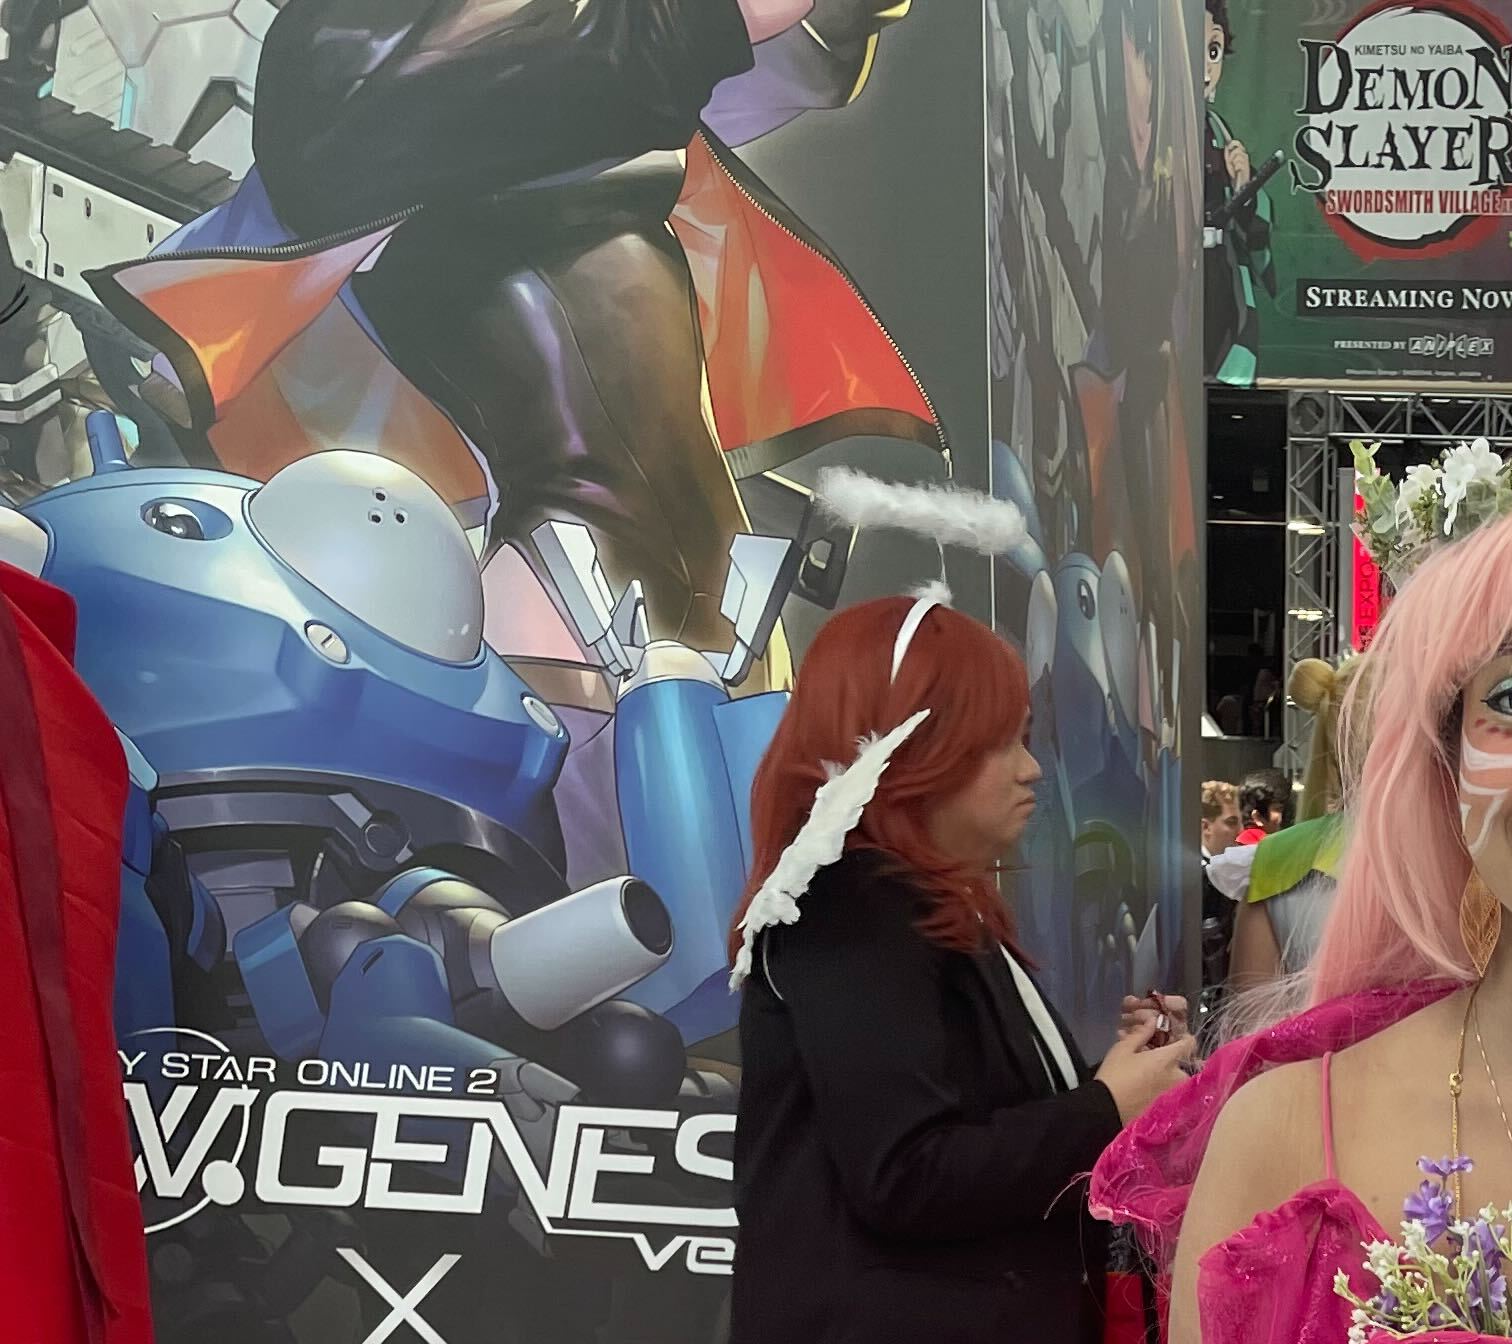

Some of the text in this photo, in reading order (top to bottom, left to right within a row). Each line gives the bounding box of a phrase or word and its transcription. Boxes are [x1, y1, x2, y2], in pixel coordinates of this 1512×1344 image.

[1354, 44, 1464, 56] KIMETSU NO YAIBA
[1326, 189, 1434, 214] SWORDSMITH
[1438, 190, 1500, 214] VILLAGE
[1306, 286, 1455, 309] STREAMING
[1409, 336, 1493, 356] ANIPLEX
[161, 1053, 277, 1083] STAR
[297, 1059, 455, 1093] ONLINE
[466, 1069, 498, 1095] 2
[255, 1089, 740, 1227] GENES
[633, 1233, 736, 1275] ve
